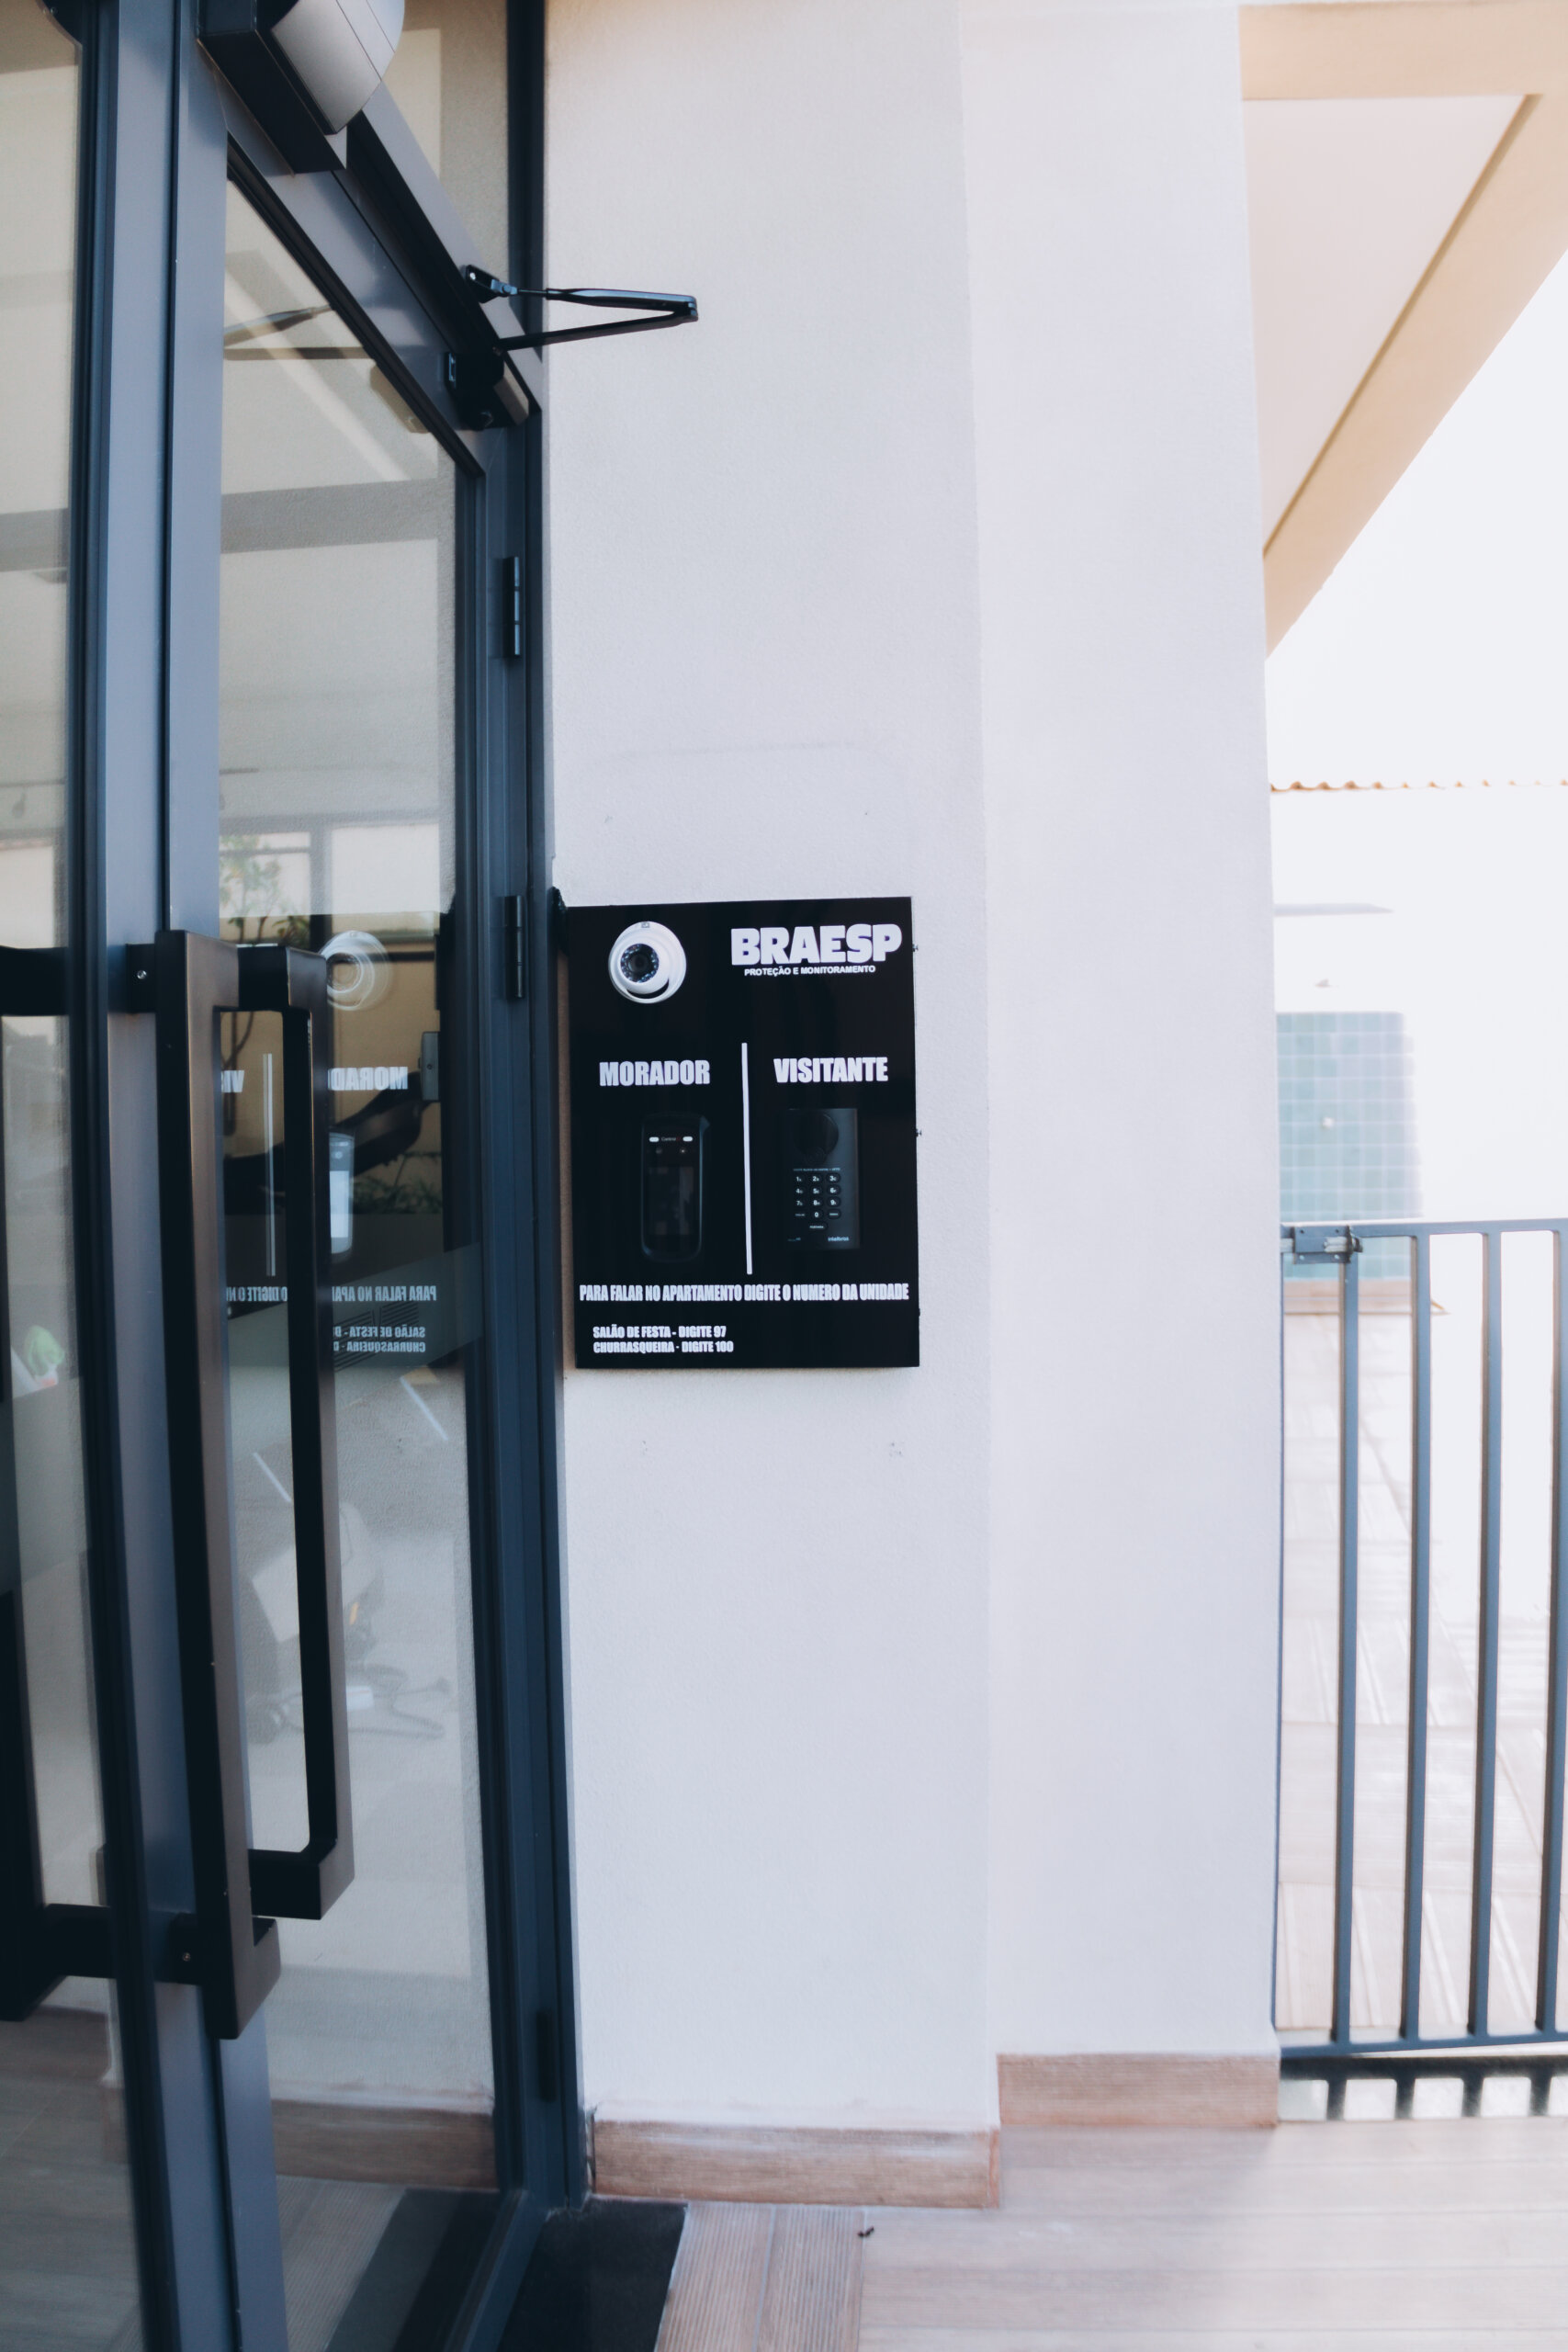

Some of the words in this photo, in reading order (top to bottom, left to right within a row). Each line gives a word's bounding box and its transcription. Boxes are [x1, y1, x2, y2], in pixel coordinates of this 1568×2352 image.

[731, 923, 902, 966] BRAESP
[744, 967, 791, 977] PROTEÇÃO
[793, 967, 798, 975] E
[801, 966, 875, 975] MONITORAMENTO
[599, 1060, 710, 1086] MORADOR
[773, 1057, 888, 1083] VISITANTE
[580, 1284, 608, 1301] PARA
[610, 1284, 643, 1301] FALAR
[645, 1284, 660, 1301] NO
[662, 1284, 742, 1301] APARTAMENTO
[744, 1283, 781, 1301] DIGITE
[783, 1284, 791, 1301] O
[793, 1283, 840, 1301] NUMERO
[842, 1283, 858, 1300] DA
[859, 1283, 909, 1300] UNIDADE
[592, 1324, 625, 1338] SALÃO
[626, 1326, 639, 1338] DE
[641, 1326, 671, 1338] FESTA
[678, 1326, 712, 1338] DIGITE
[714, 1326, 727, 1338] 97
[593, 1341, 675, 1354] CHURRASQUEIRA
[682, 1340, 714, 1352] DIGITE
[716, 1340, 734, 1352] 100
